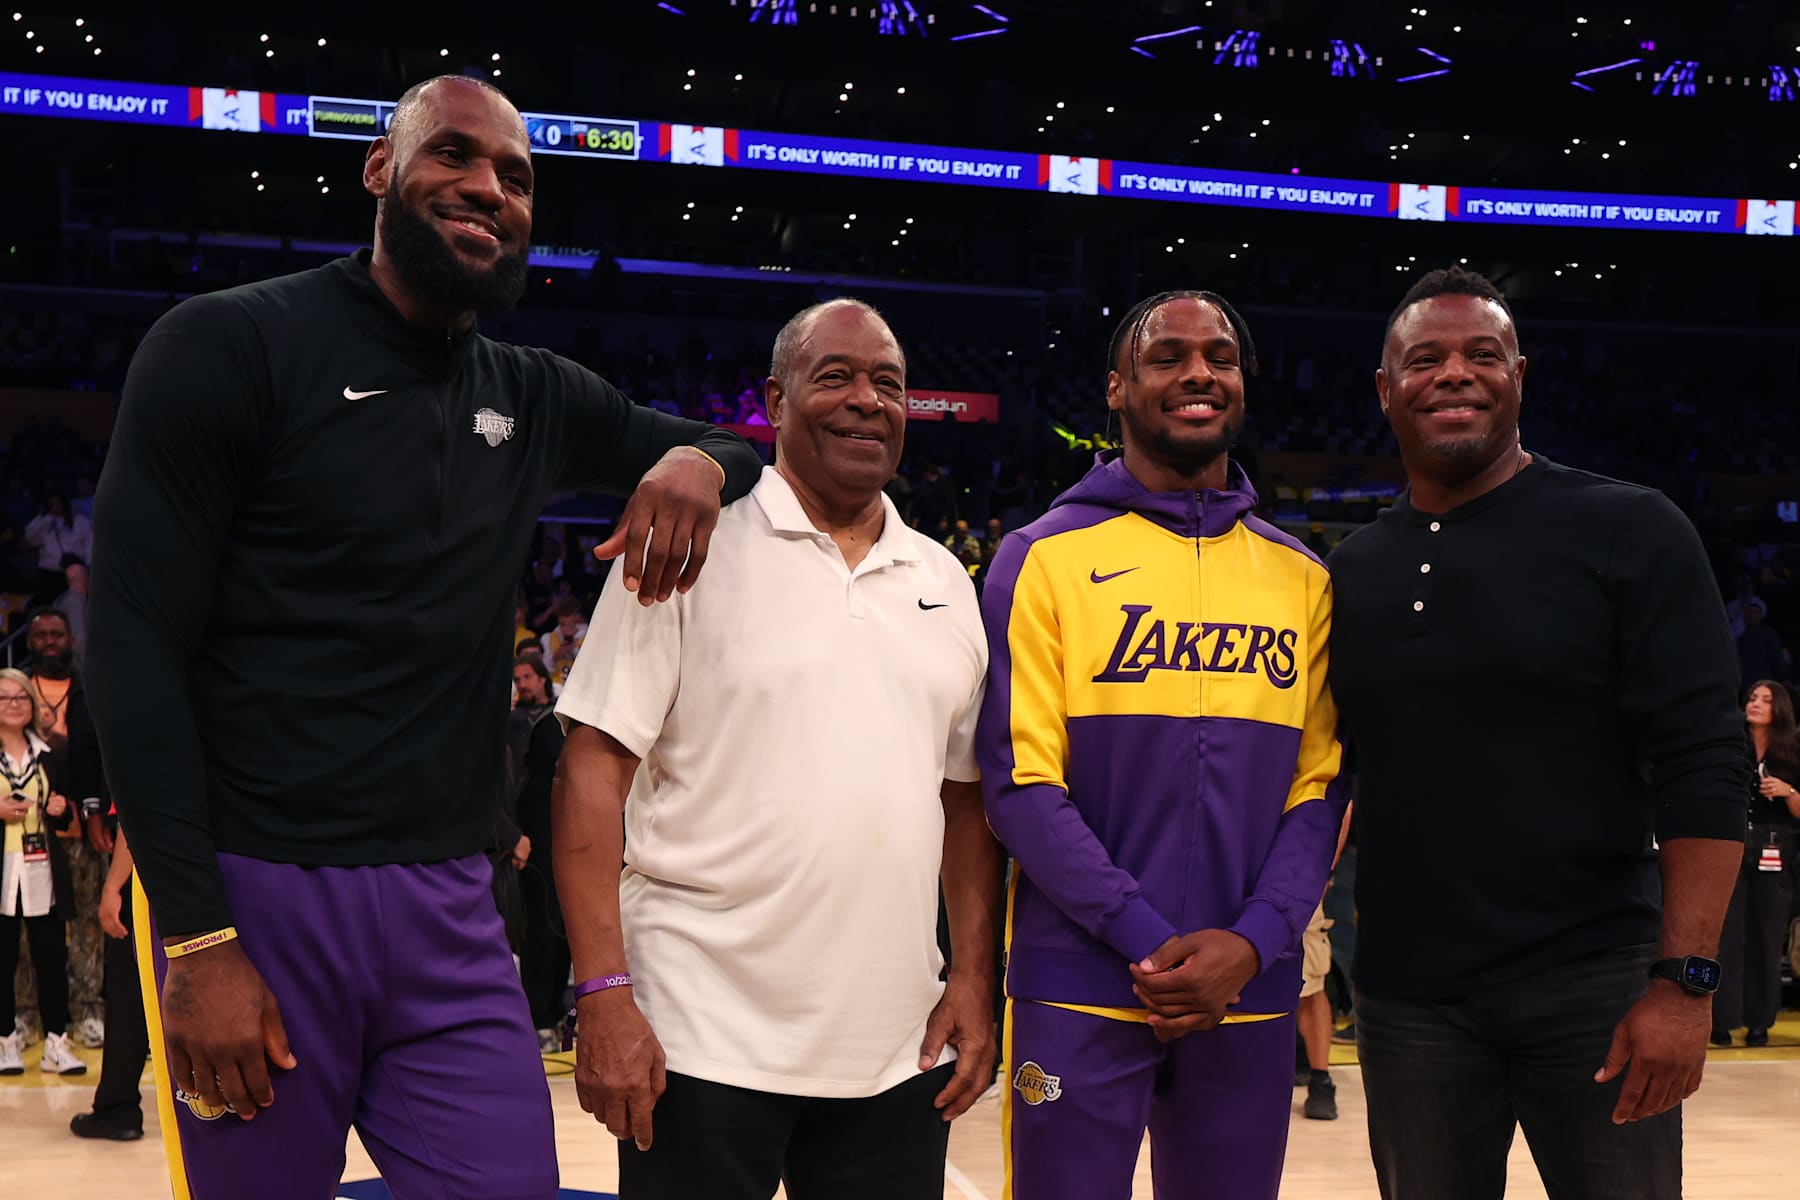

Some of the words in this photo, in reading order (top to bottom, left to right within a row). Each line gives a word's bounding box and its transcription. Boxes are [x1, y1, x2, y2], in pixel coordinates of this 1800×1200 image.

[4, 87, 20, 104] IT
[24, 88, 41, 105] IF
[45, 90, 83, 109] YOU
[88, 93, 147, 114] ENJOY
[152, 98, 168, 115] IT
[314, 109, 376, 126] TURNOVERS
[546, 124, 561, 146] 0
[586, 128, 634, 151] 6:30
[748, 143, 776, 160] IT'S
[778, 146, 819, 164] ONLY
[822, 150, 879, 169] WORTH
[882, 155, 897, 170] IT
[899, 156, 915, 171] IF
[917, 157, 950, 174] YOU
[953, 160, 1003, 178] ENJOY
[1006, 165, 1021, 179] IT
[1120, 173, 1146, 190] IT'S
[1149, 176, 1187, 193] ONLY
[1189, 180, 1242, 197] WORTH
[1245, 184, 1259, 198] IT
[1261, 186, 1275, 200] IF
[1277, 187, 1307, 203] YOU
[1310, 189, 1357, 206] ENJOY
[1360, 193, 1374, 207] IT
[1467, 199, 1493, 214] IT'S
[1495, 201, 1533, 216] ONLY
[1535, 203, 1588, 218] WORTH
[1591, 205, 1604, 219] IT
[1606, 206, 1620, 220] IF
[1623, 206, 1653, 221] YOU
[1656, 208, 1704, 223] ENJOY
[1706, 210, 1721, 224] IT
[472, 413, 515, 440] LAKERS
[1092, 604, 1298, 690] LAKERS
[182, 934, 223, 952] PROMISE
[605, 976, 632, 987] 10/22
[1015, 1069, 1060, 1100] LAKERS
